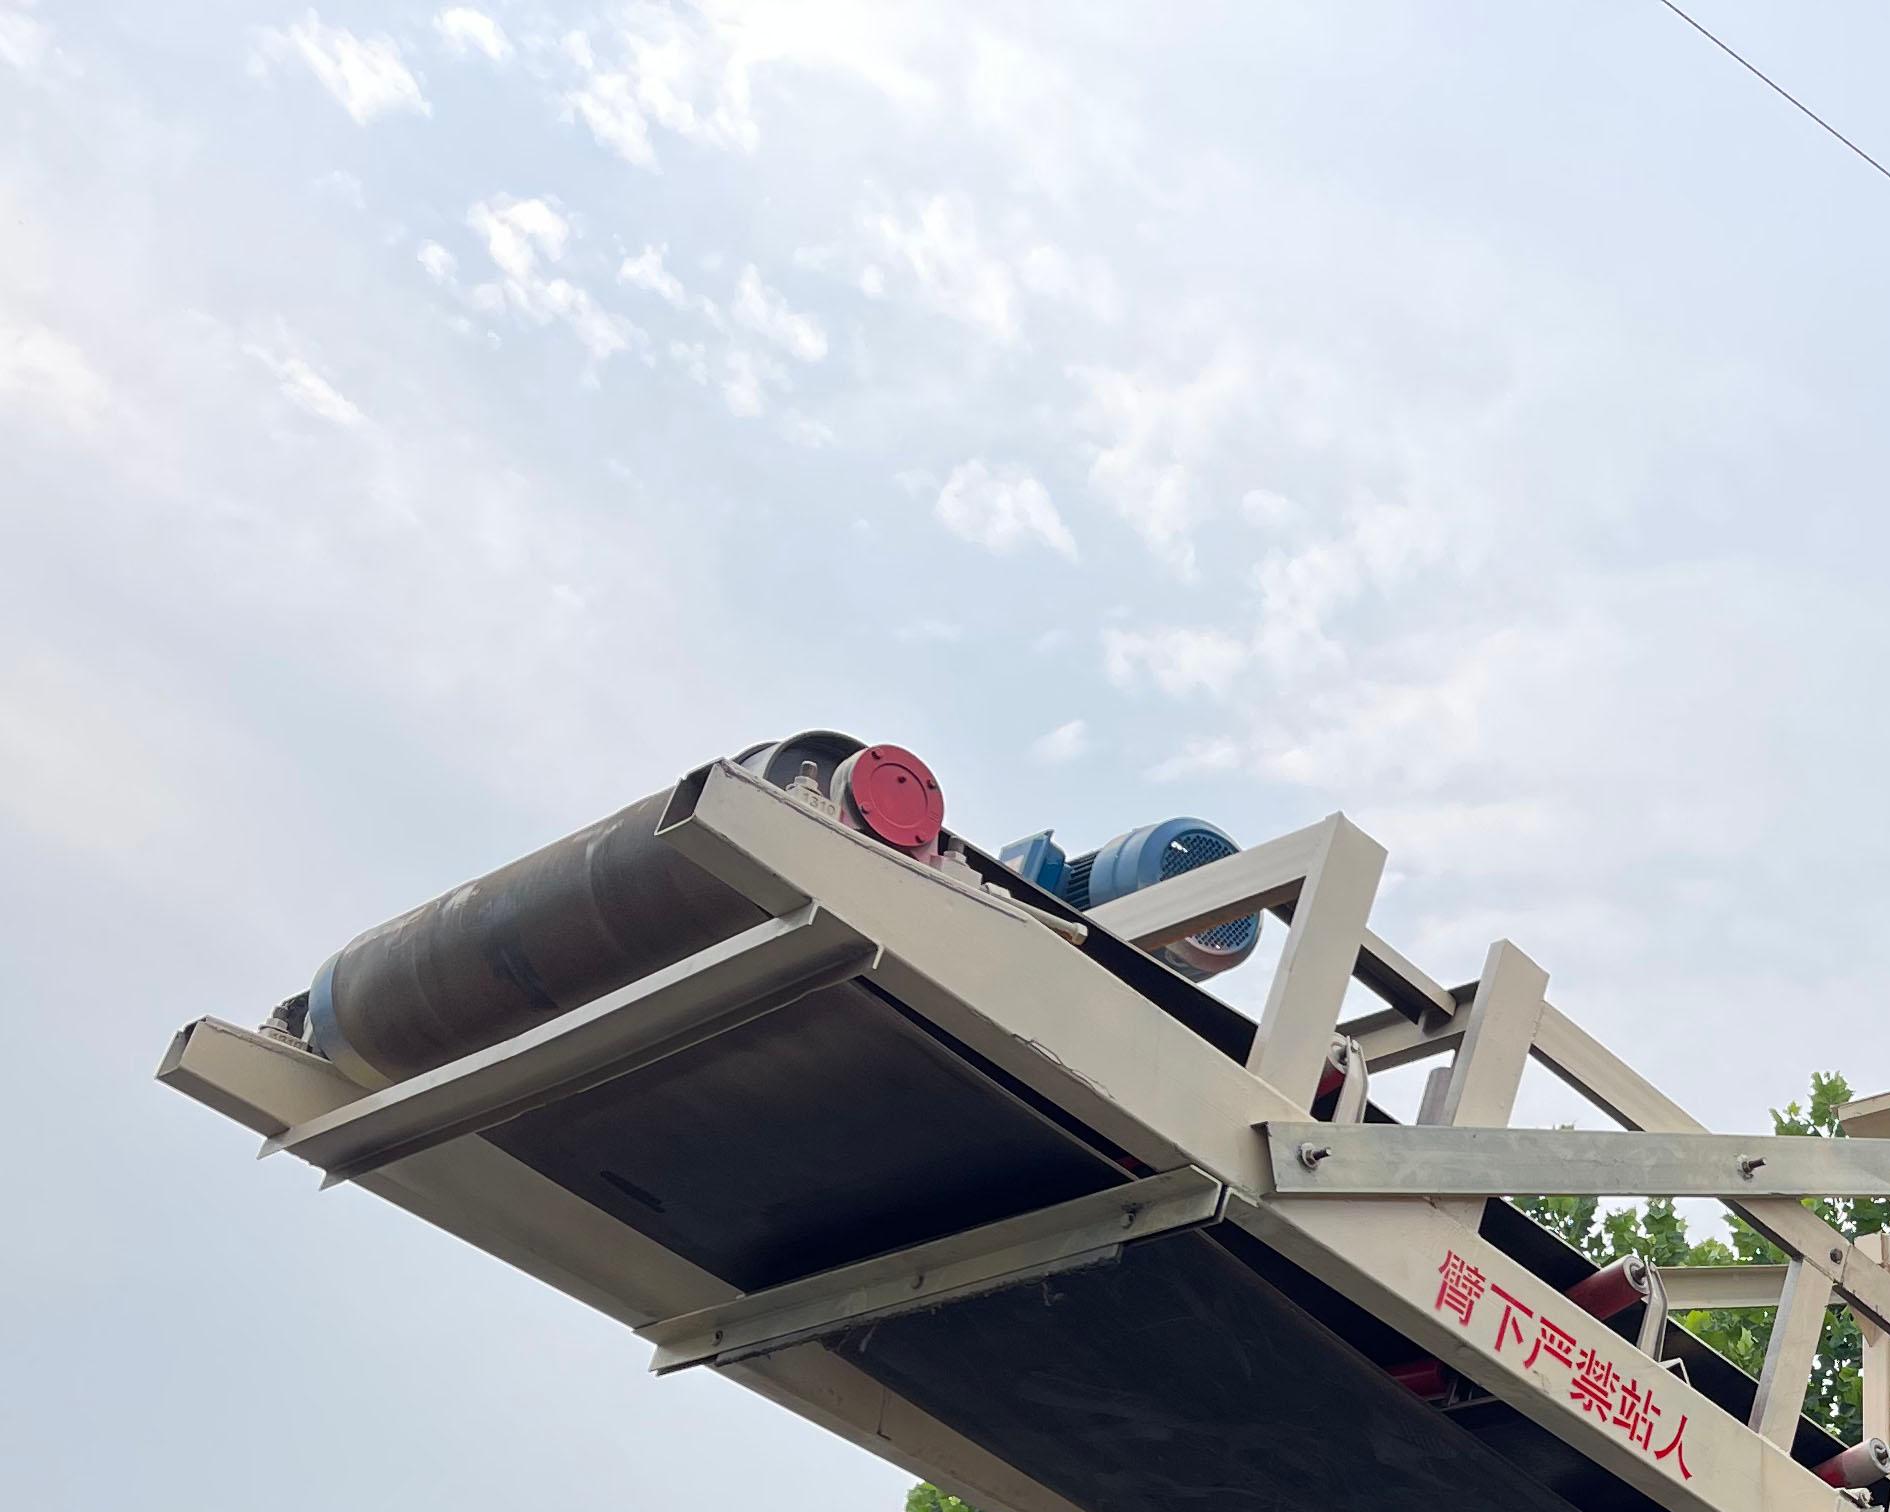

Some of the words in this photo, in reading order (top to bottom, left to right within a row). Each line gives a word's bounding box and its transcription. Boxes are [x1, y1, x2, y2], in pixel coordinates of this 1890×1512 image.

[1435, 1250, 1693, 1480] 臂下严禁站人
